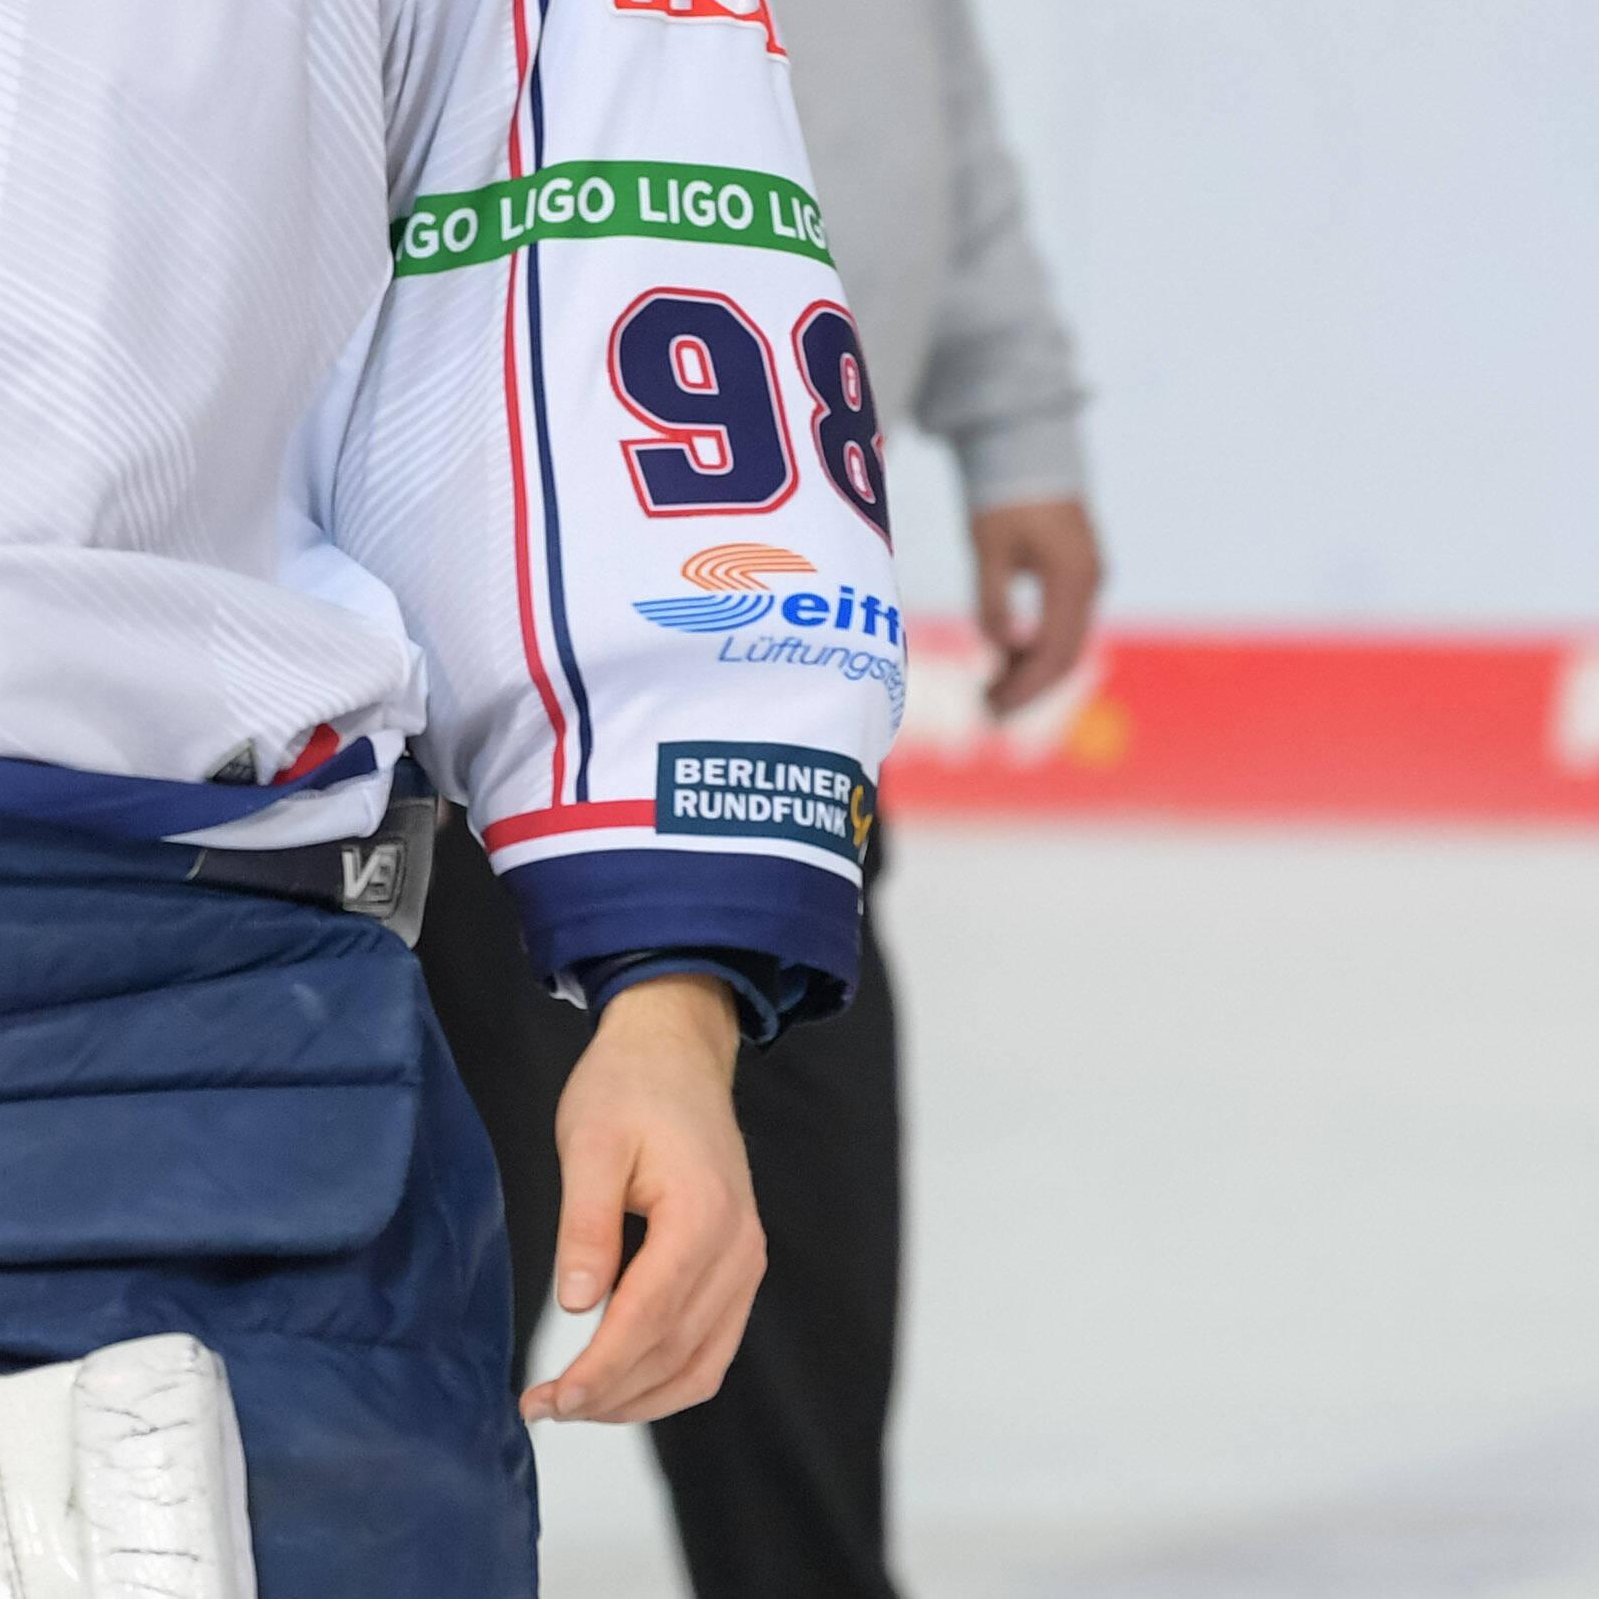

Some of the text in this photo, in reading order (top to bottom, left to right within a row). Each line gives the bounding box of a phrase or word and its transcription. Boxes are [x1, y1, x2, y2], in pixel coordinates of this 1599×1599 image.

[396, 177, 828, 261] GO LIGO LIGO LIG
[607, 287, 893, 554] 98
[673, 788, 847, 839] RUNDFUNK
[674, 757, 852, 804] BERLINER
